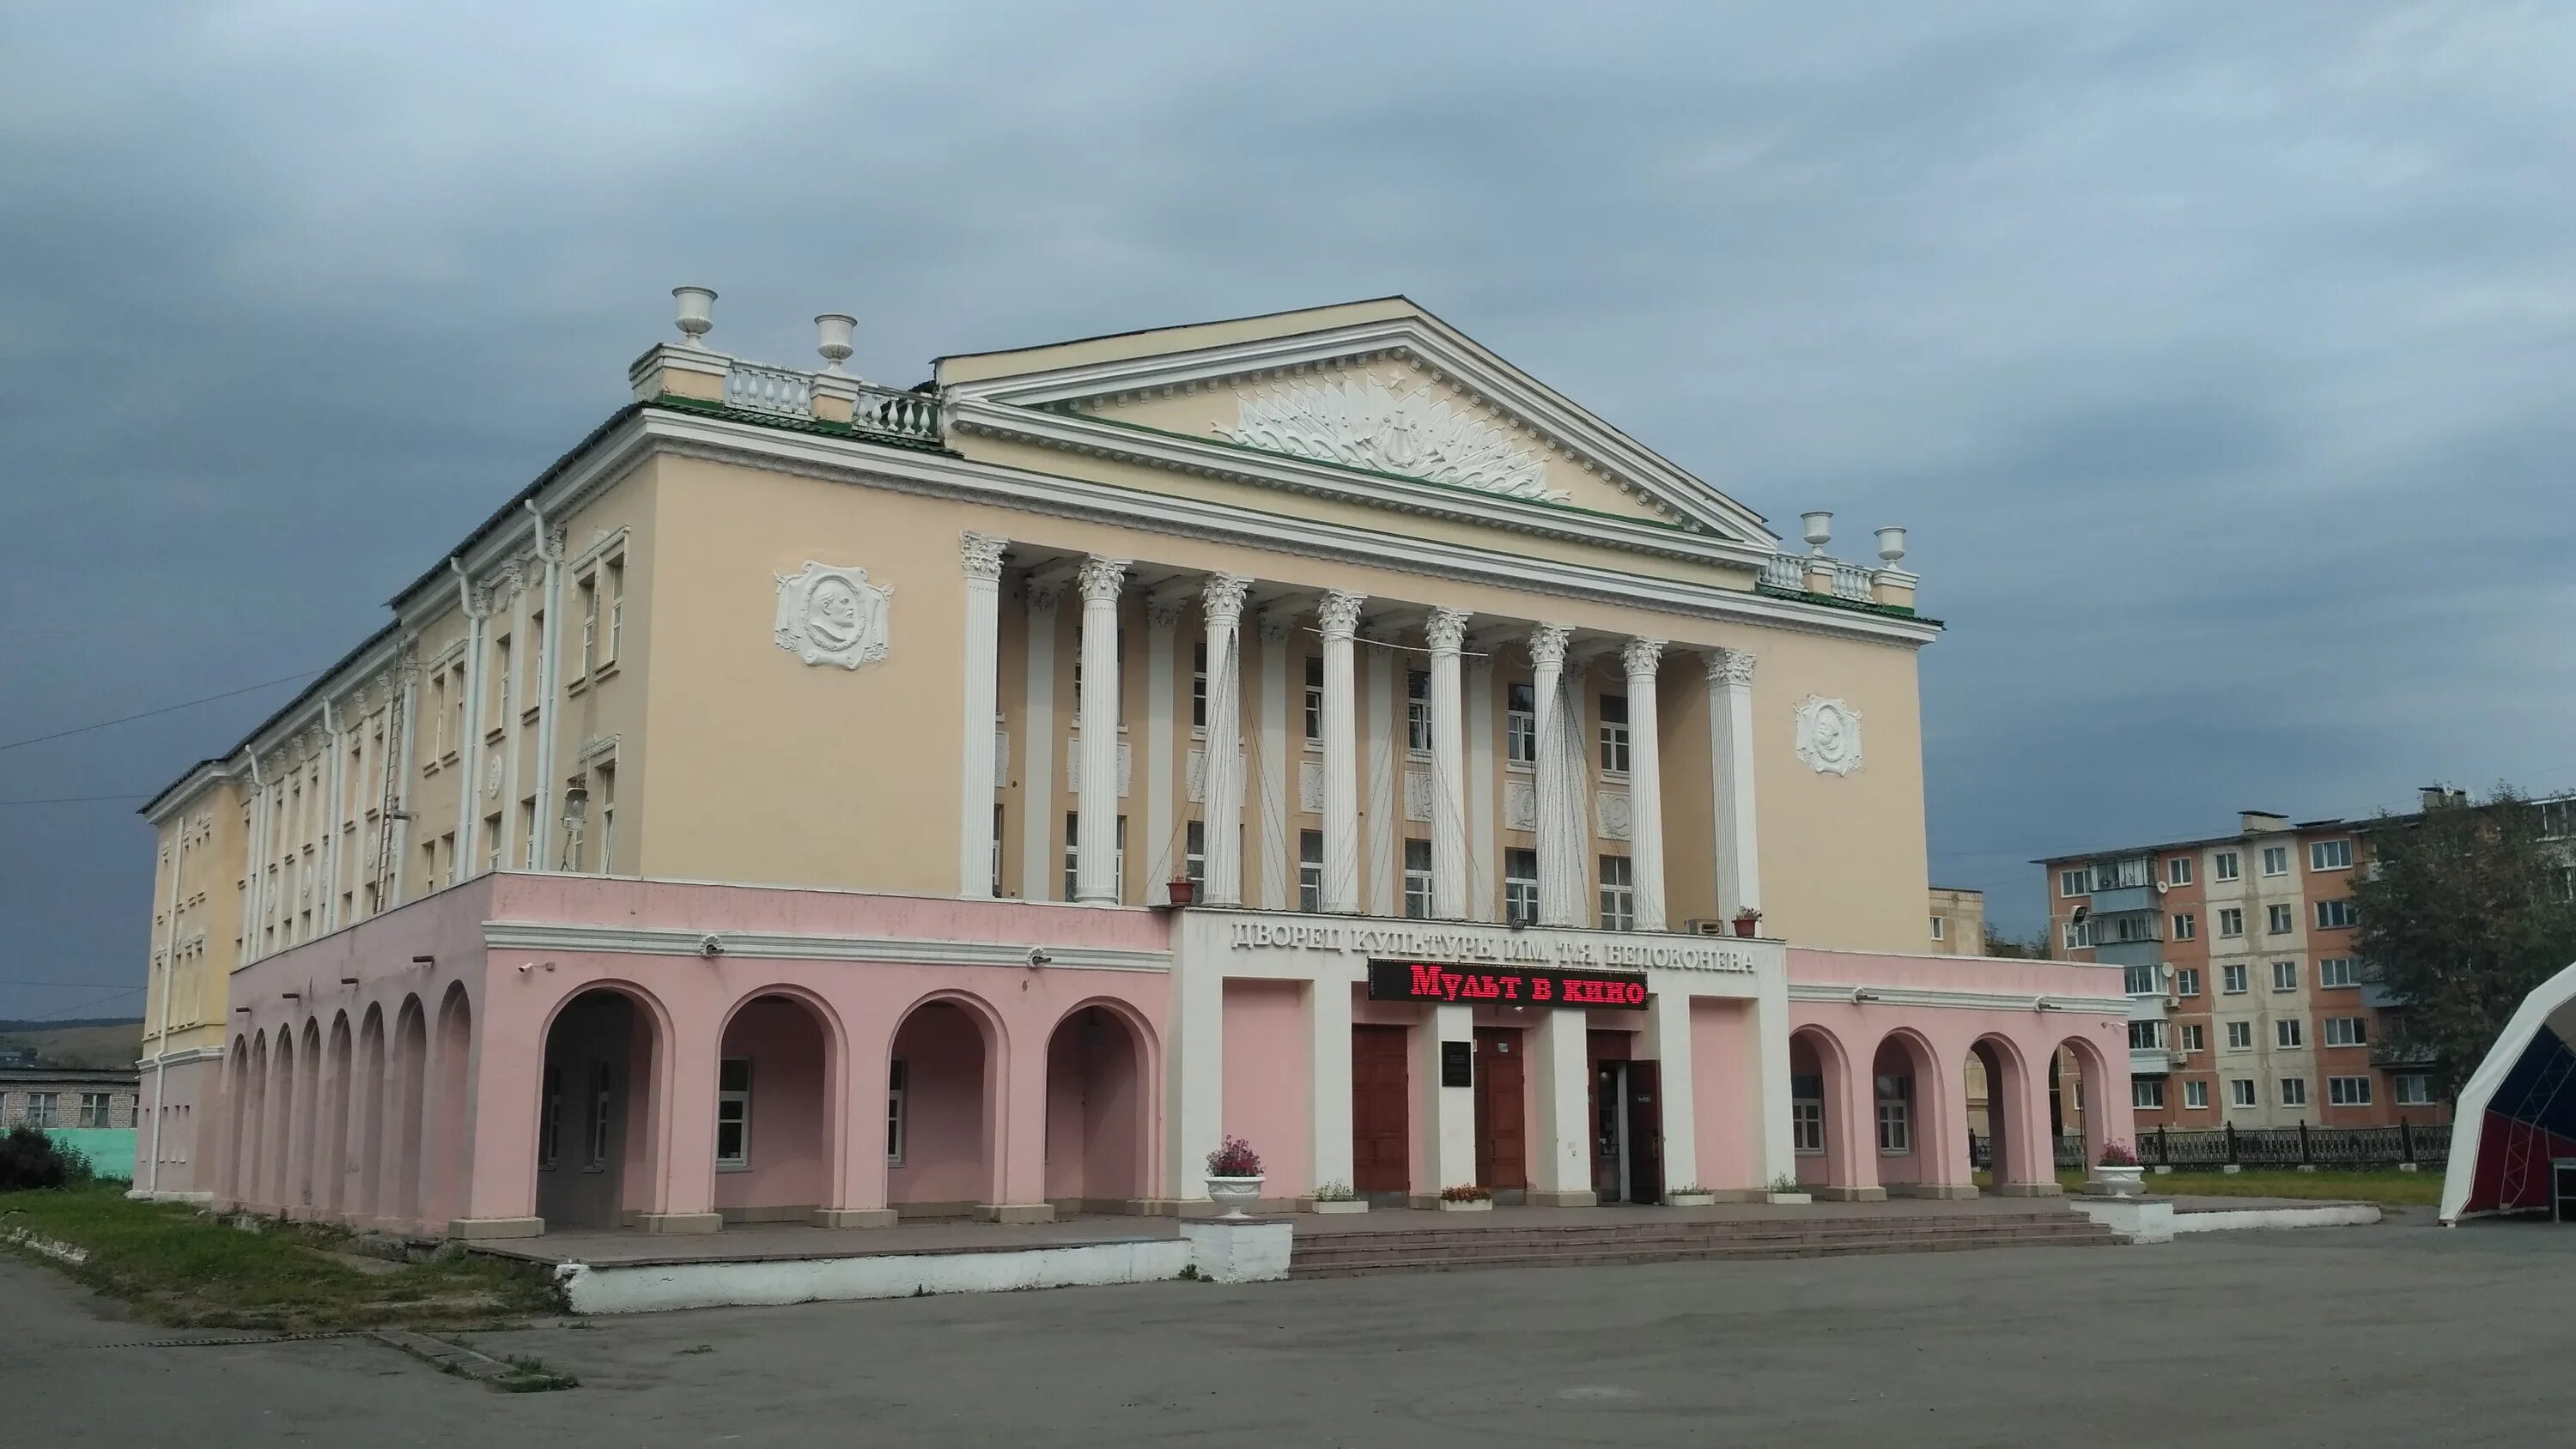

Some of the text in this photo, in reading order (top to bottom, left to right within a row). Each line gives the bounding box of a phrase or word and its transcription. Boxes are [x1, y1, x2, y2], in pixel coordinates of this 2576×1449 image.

[1231, 921, 1344, 954] ДВОРЕЦ
[1351, 928, 1498, 960] КУЛЬТУРЫ
[1504, 939, 1552, 963] ИМ.
[1605, 944, 1755, 973] БЕЛОКОНЕВА
[1410, 965, 1522, 1001] Мульт
